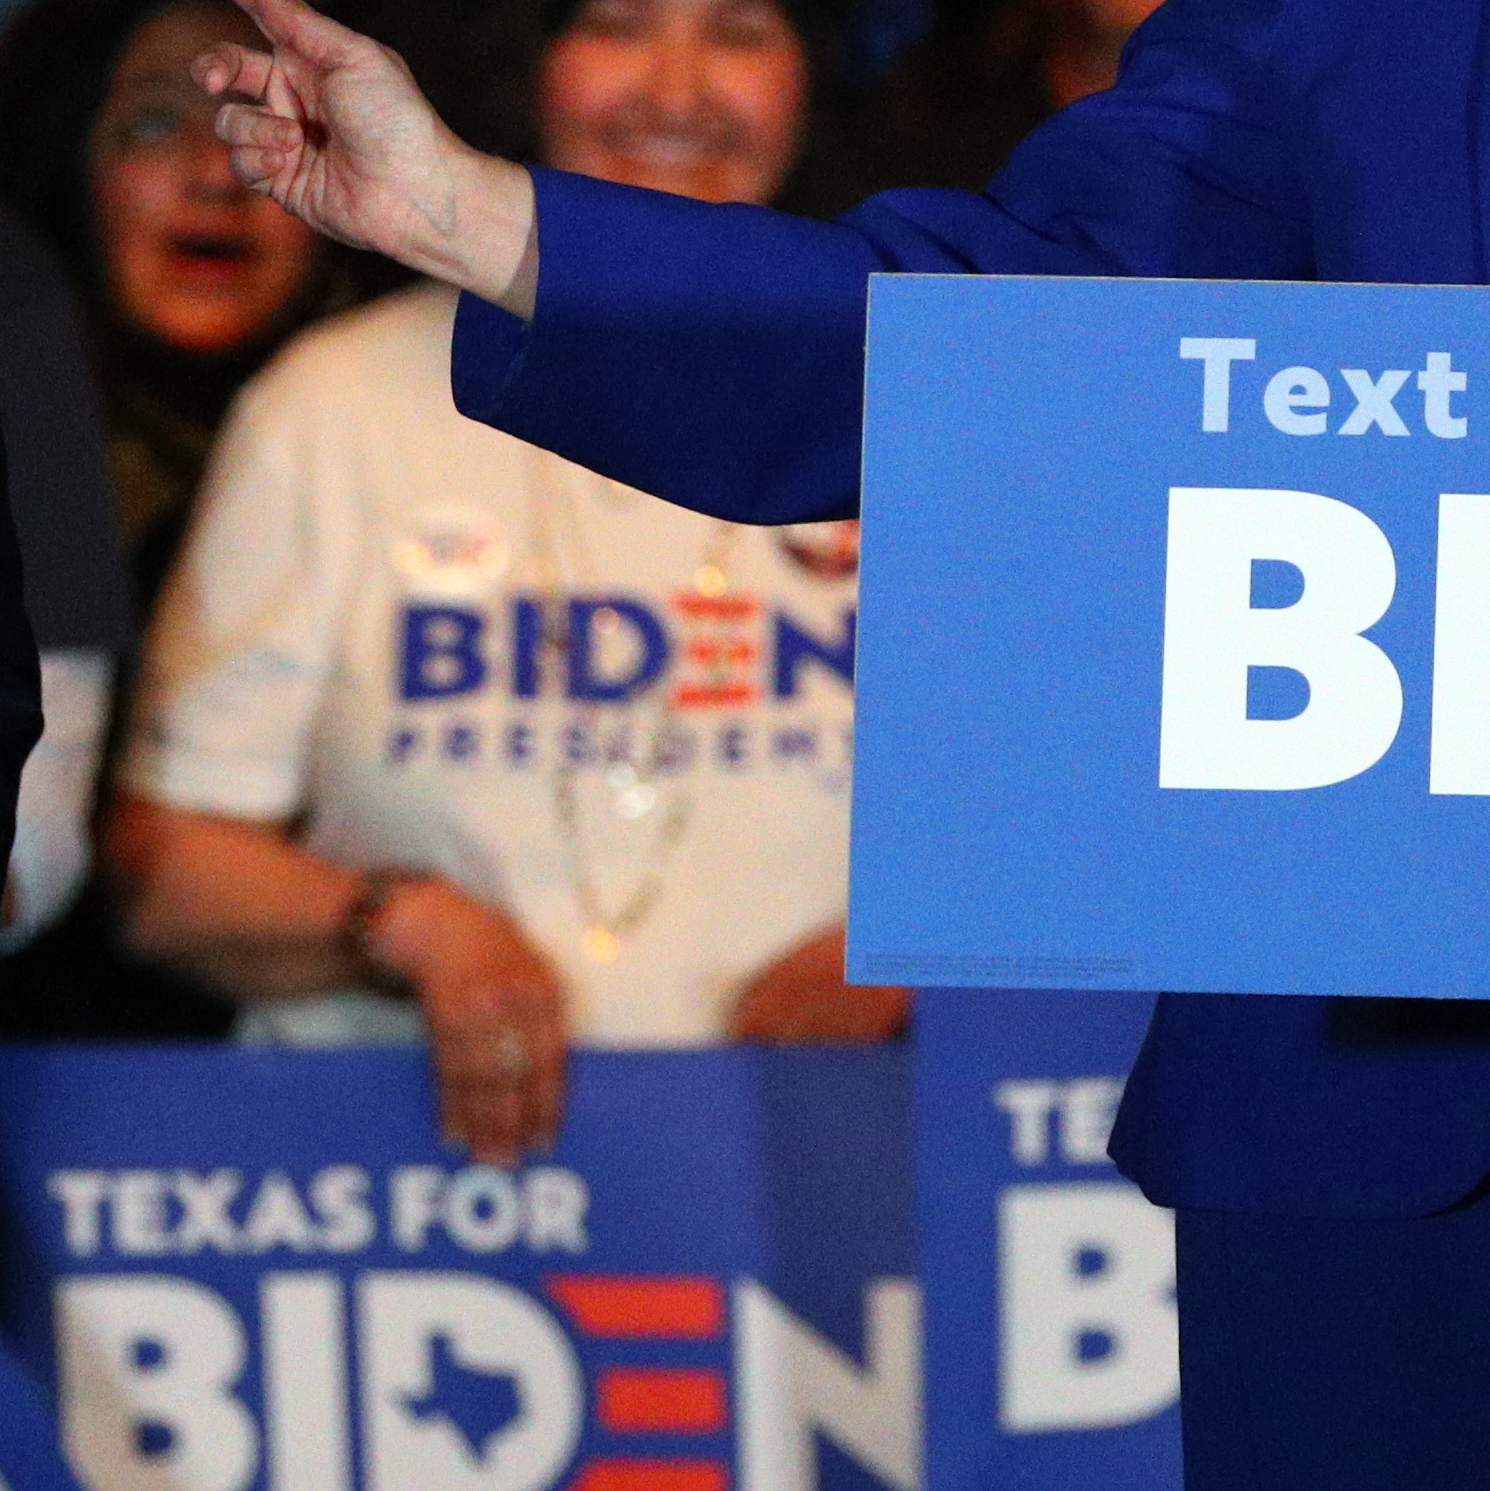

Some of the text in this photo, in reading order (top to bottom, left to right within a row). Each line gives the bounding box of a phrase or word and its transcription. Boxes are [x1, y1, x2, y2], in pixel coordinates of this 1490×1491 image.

[1179, 337, 1467, 440] Text
[399, 590, 856, 710] BIDEN
[48, 1164, 590, 1256] TEXAS FOR
[54, 1269, 925, 1491] BIDEN
